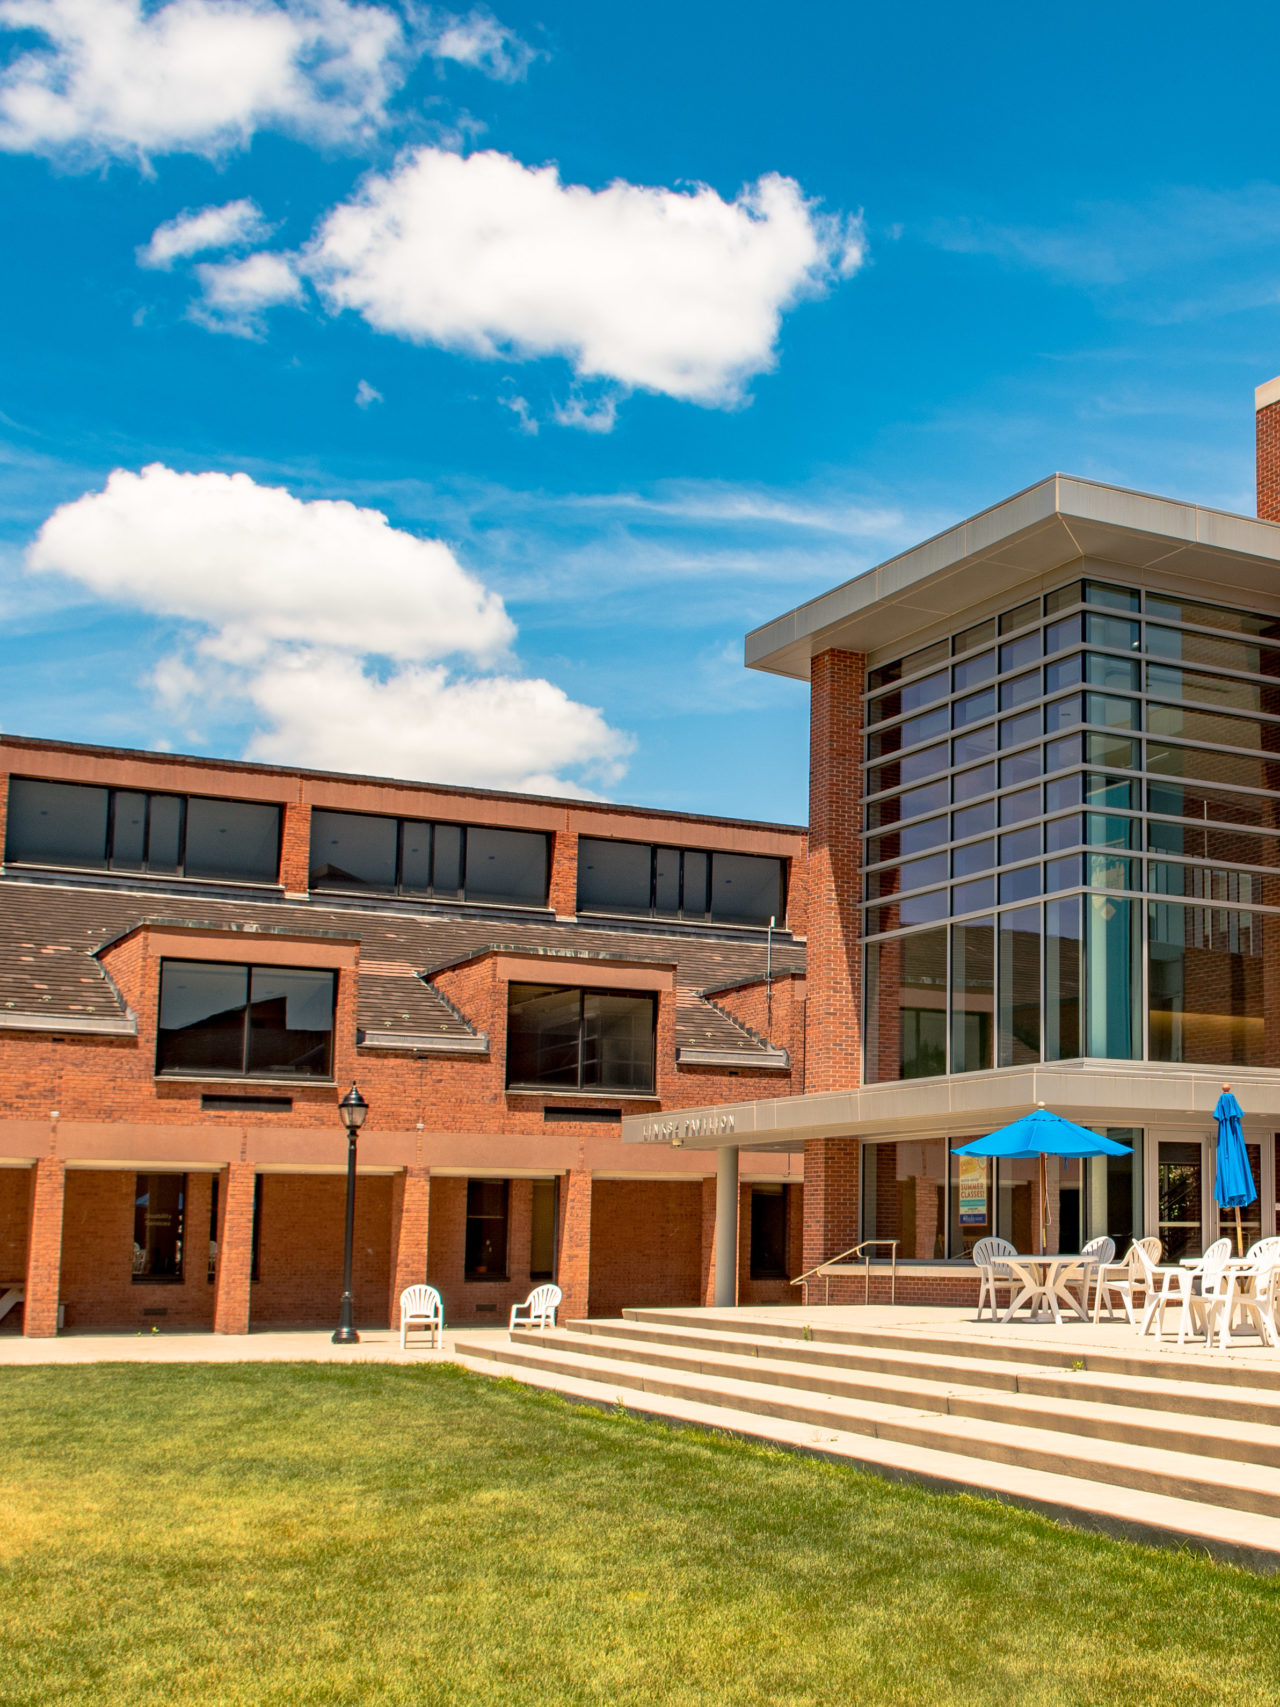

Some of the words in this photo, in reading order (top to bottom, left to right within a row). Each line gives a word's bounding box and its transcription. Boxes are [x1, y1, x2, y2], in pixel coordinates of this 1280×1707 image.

[684, 1114, 735, 1132] PAVILION
[960, 1182, 984, 1191] SUMMER
[960, 1190, 985, 1199] CLASSES!
